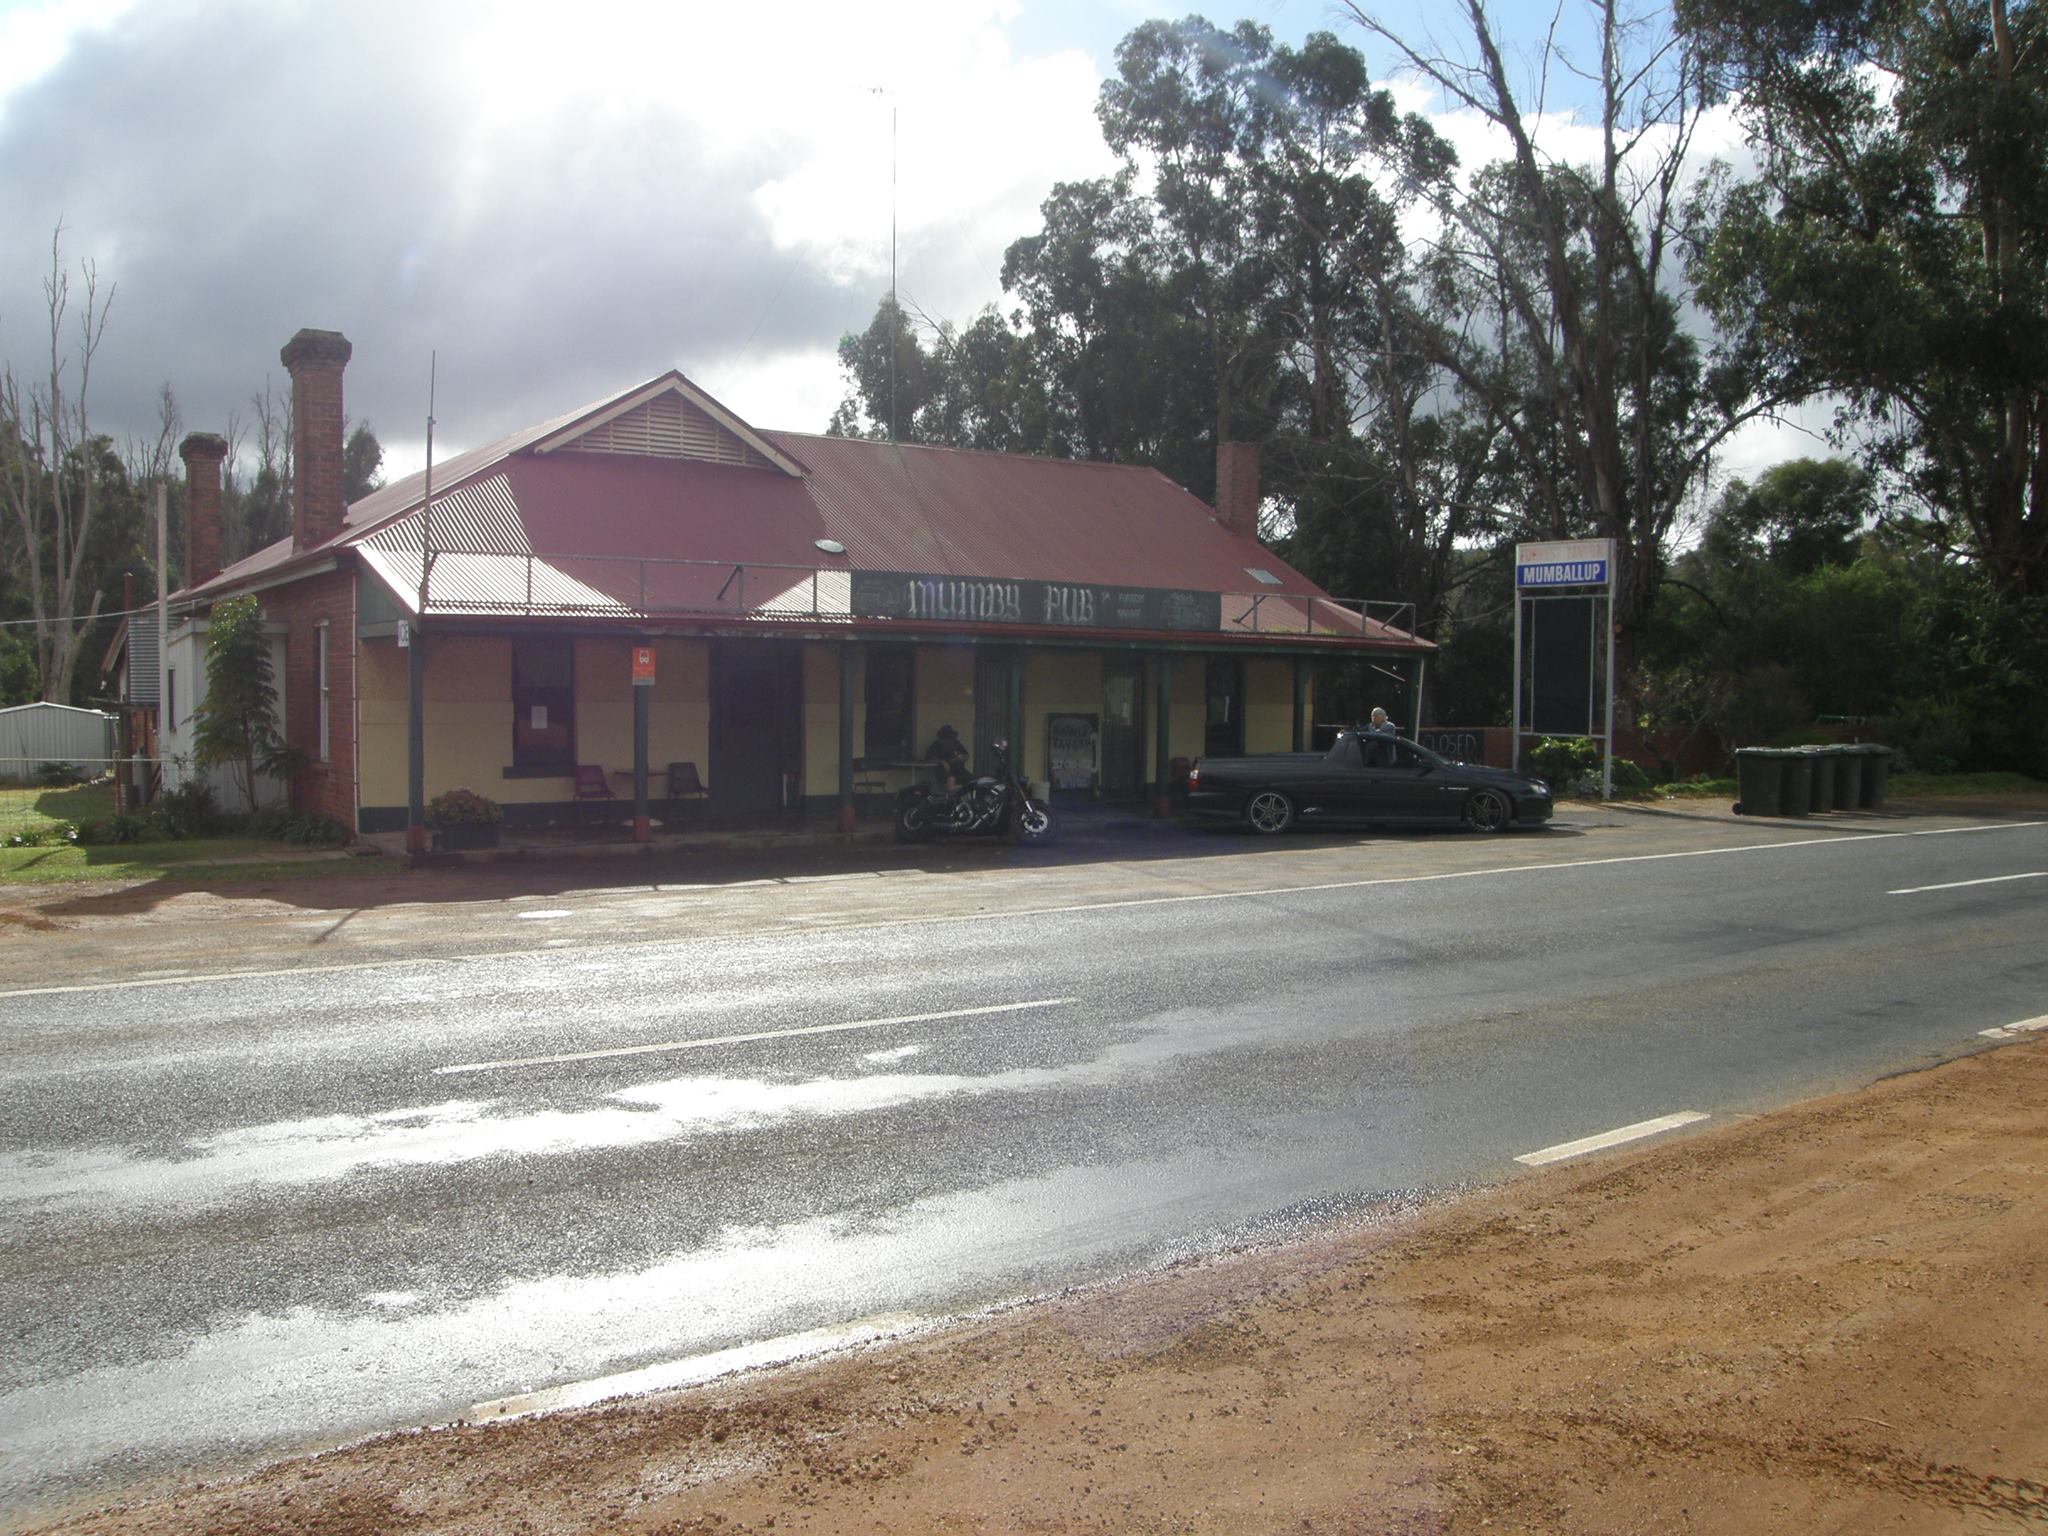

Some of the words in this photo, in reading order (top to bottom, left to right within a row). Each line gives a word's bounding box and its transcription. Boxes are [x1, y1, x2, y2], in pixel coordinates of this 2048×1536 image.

[1523, 563, 1600, 584] MUMBALLUP
[906, 579, 1022, 620] MUMBY
[1042, 584, 1095, 622] PUB
[1423, 733, 1477, 754] CLOSED
